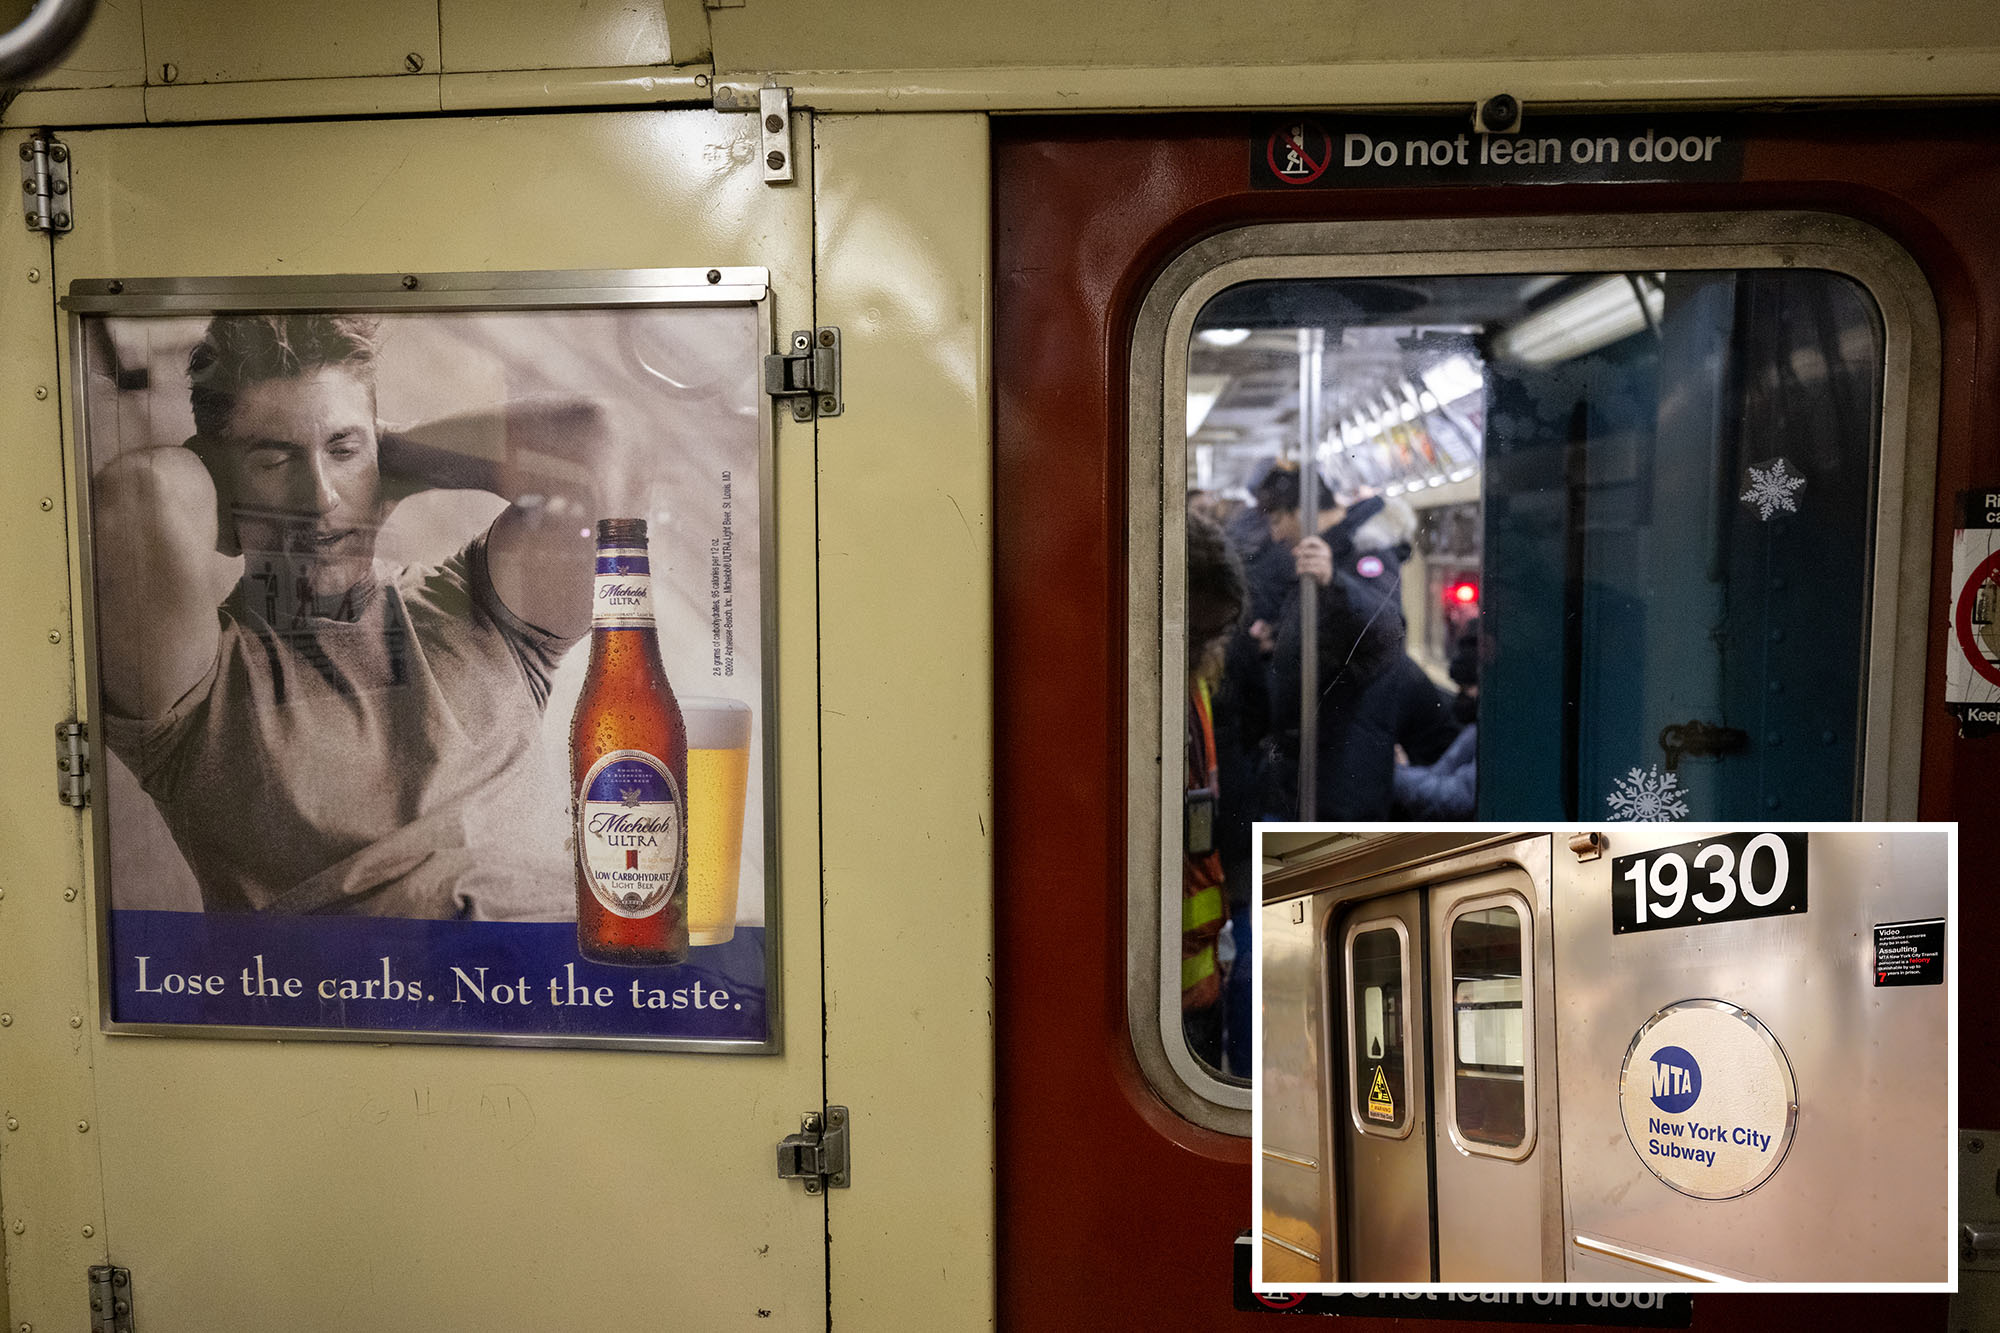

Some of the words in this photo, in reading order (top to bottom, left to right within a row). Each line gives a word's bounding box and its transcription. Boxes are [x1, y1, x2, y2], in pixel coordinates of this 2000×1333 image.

[1344, 133, 1398, 167] Do
[1404, 133, 1469, 167] not
[1480, 132, 1561, 166] lean
[1570, 137, 1620, 164] on
[1628, 128, 1722, 163] door
[712, 555, 720, 566] per
[722, 542, 732, 562] ULTRA
[711, 567, 720, 590] calories
[599, 584, 647, 599] Michelob
[610, 598, 640, 606] ULTRA
[713, 648, 722, 666] grams
[588, 812, 671, 834] Michelob
[608, 835, 658, 846] ULTRA
[595, 870, 610, 880] LOW
[1624, 832, 1789, 924] 1930
[612, 881, 634, 889] LIGHT
[1878, 946, 1918, 954] Assaulting
[135, 955, 225, 995] Lose
[239, 954, 303, 997] the
[318, 956, 435, 1002] carbs.
[450, 966, 533, 1005] Not
[547, 962, 614, 1006] the
[629, 979, 742, 1011] taste.
[1878, 972, 1887, 982] 7
[1650, 1059, 1692, 1098] MTA
[1649, 1117, 1684, 1137] New
[1687, 1121, 1728, 1143] York
[1732, 1127, 1771, 1153] City
[1649, 1139, 1716, 1168] Subway
